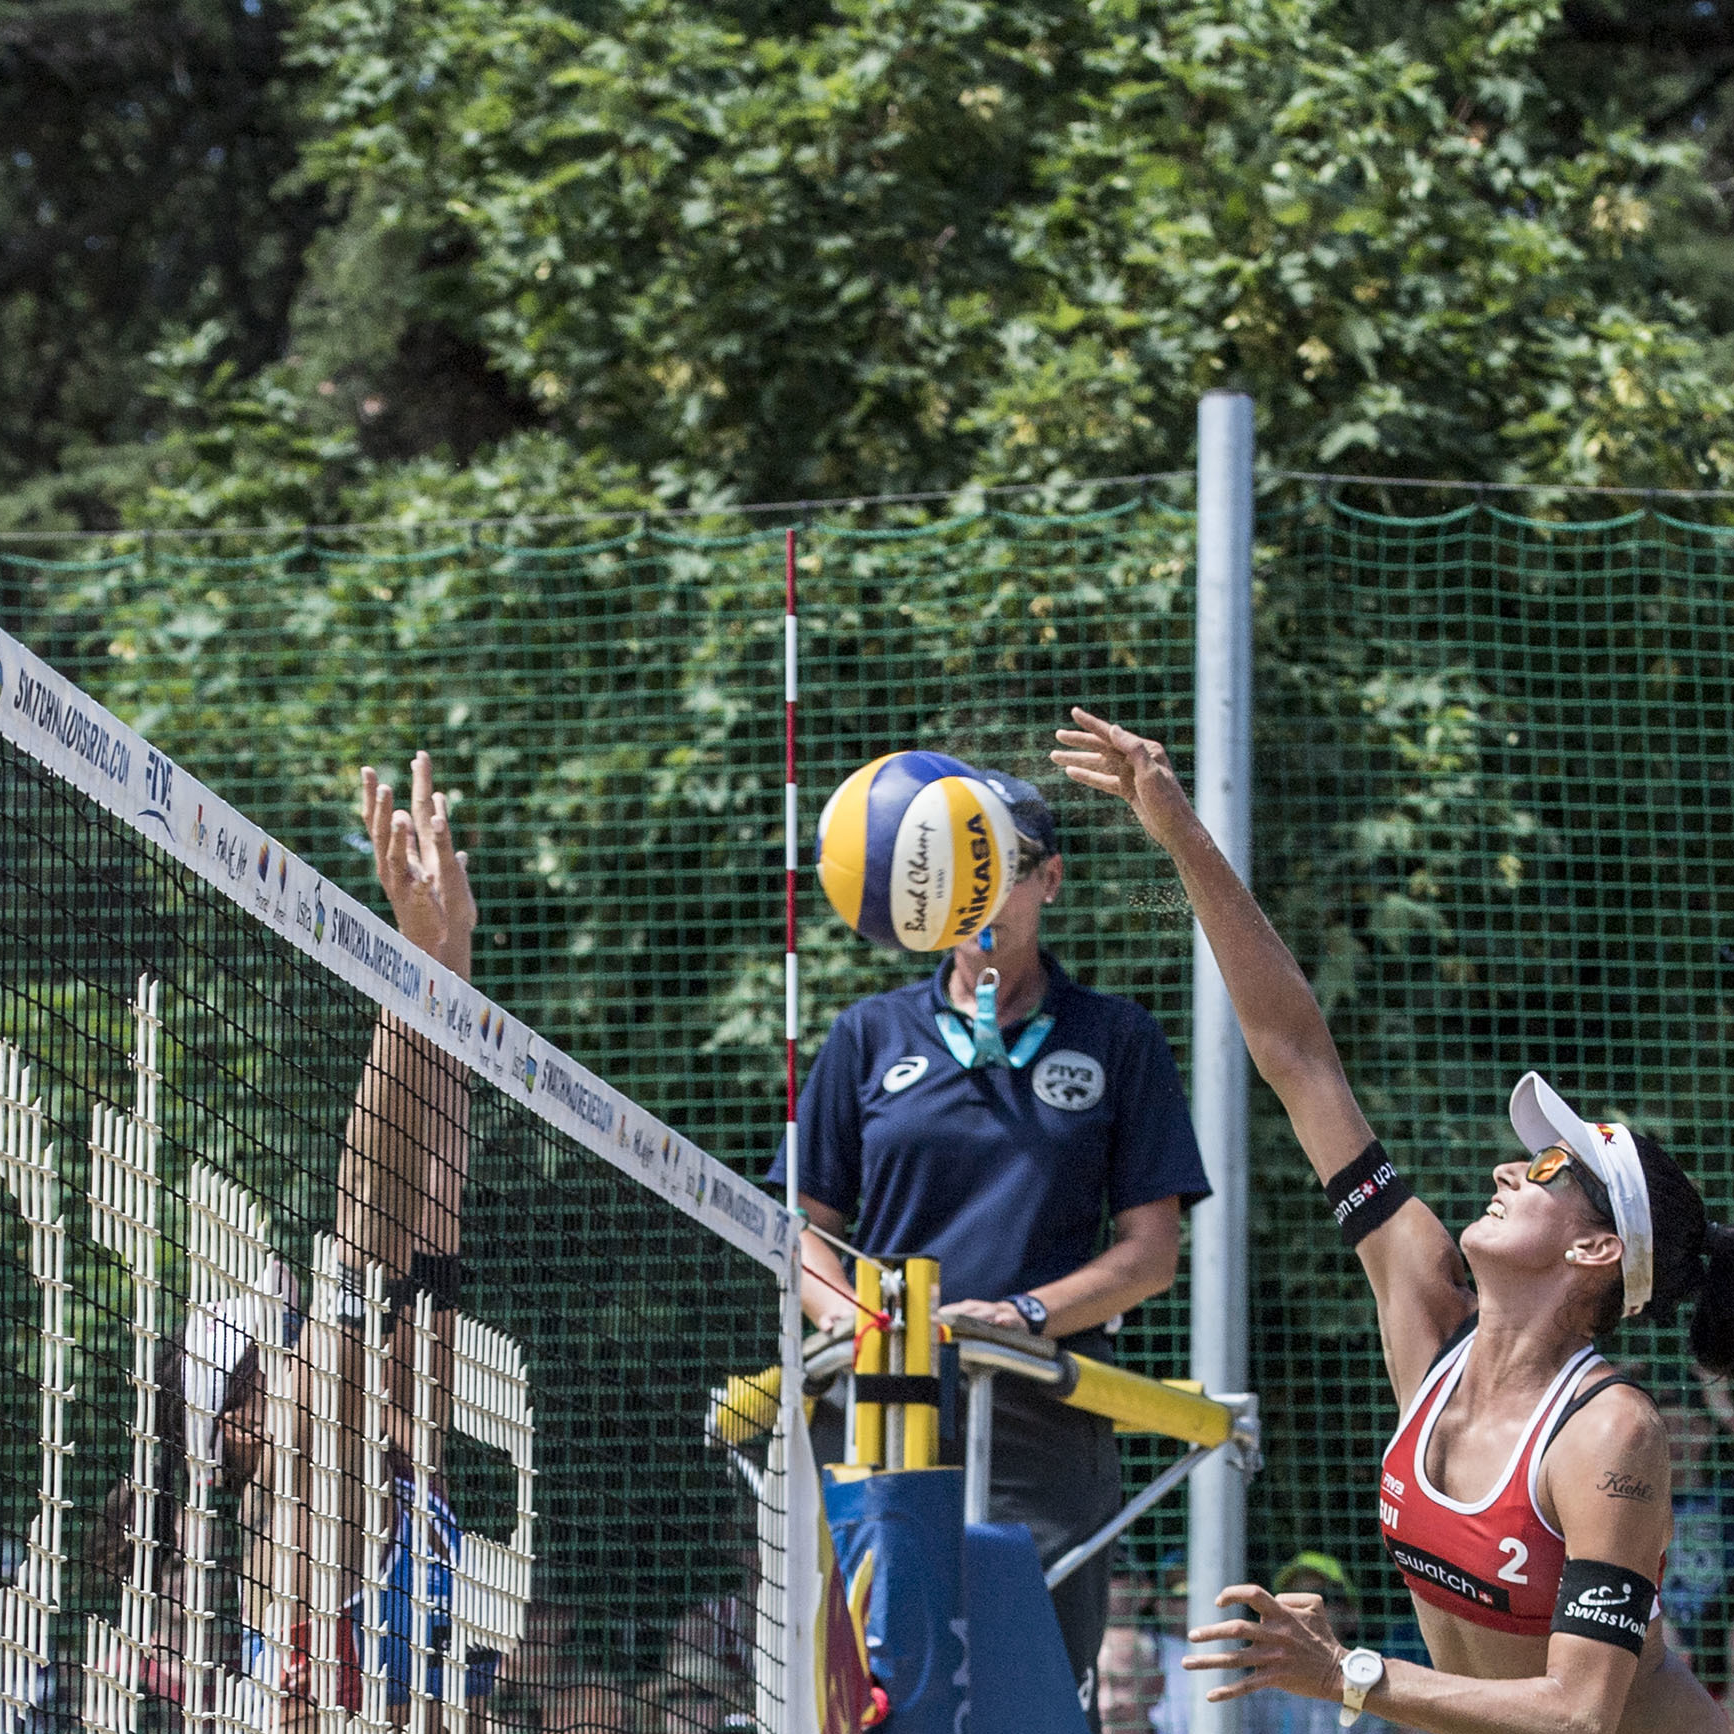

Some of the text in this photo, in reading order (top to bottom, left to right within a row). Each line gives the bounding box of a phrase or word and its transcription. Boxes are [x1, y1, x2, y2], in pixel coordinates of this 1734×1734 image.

[904, 819, 937, 932] Beach Champ
[1394, 1549, 1477, 1600] swatch
[1497, 1536, 1529, 1585] 2
